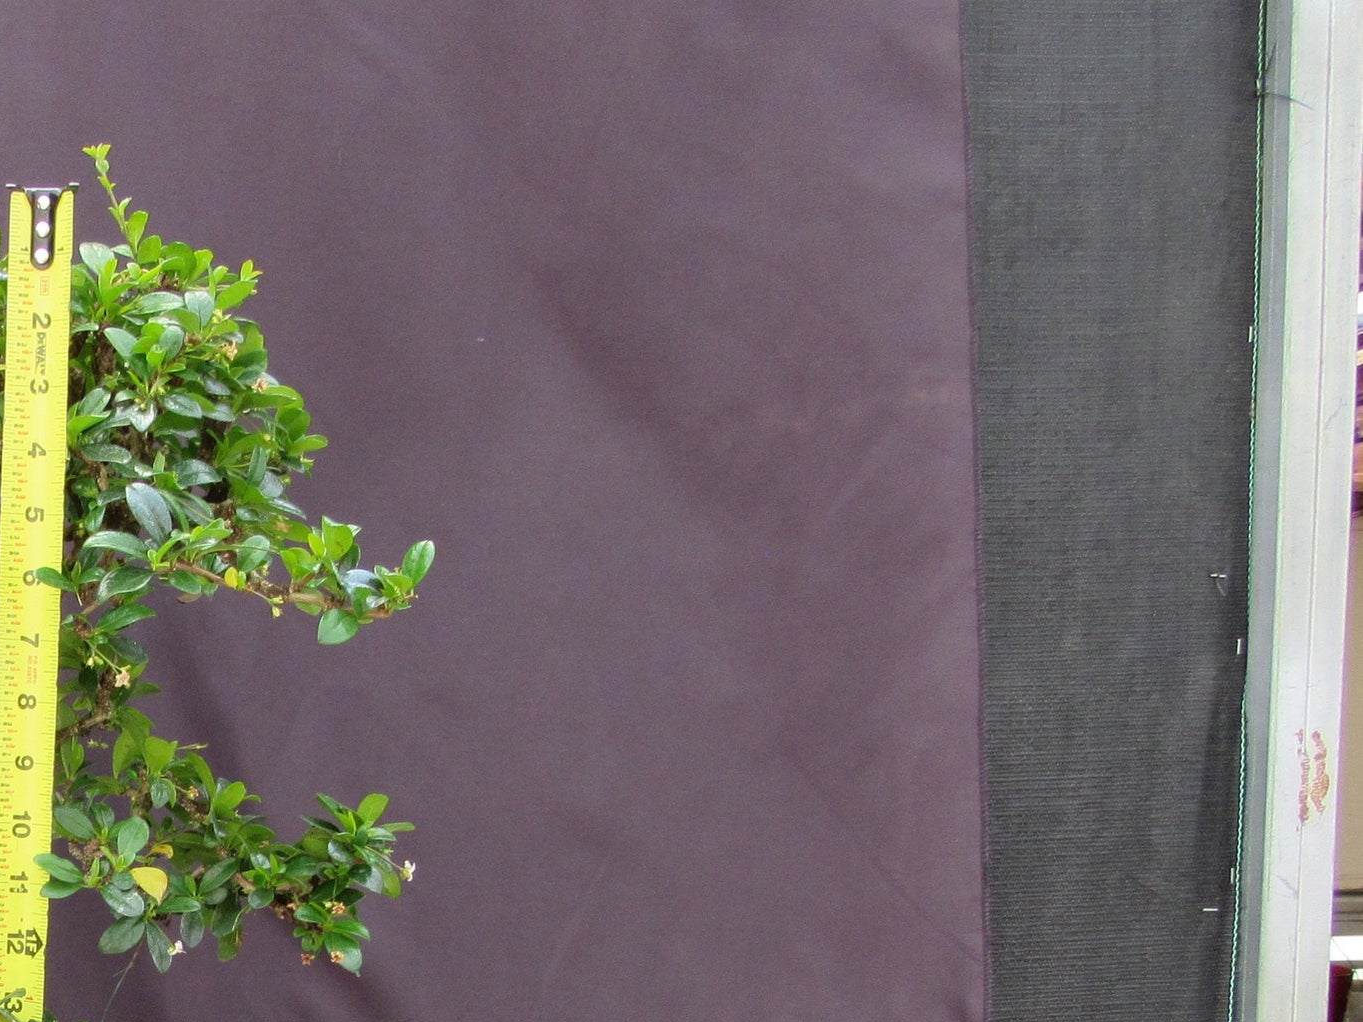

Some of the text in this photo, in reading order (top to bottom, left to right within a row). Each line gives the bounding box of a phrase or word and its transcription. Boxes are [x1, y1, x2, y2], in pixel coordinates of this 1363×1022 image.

[32, 312, 52, 330] 2
[30, 379, 50, 395] 3
[28, 442, 47, 459] 4
[25, 506, 45, 523] 5
[22, 569, 43, 587] 6
[20, 633, 40, 648] 7
[17, 693, 37, 710] 8
[15, 755, 34, 771] 9
[12, 811, 32, 839] 10
[9, 871, 29, 894] 11
[7, 929, 25, 955] 12
